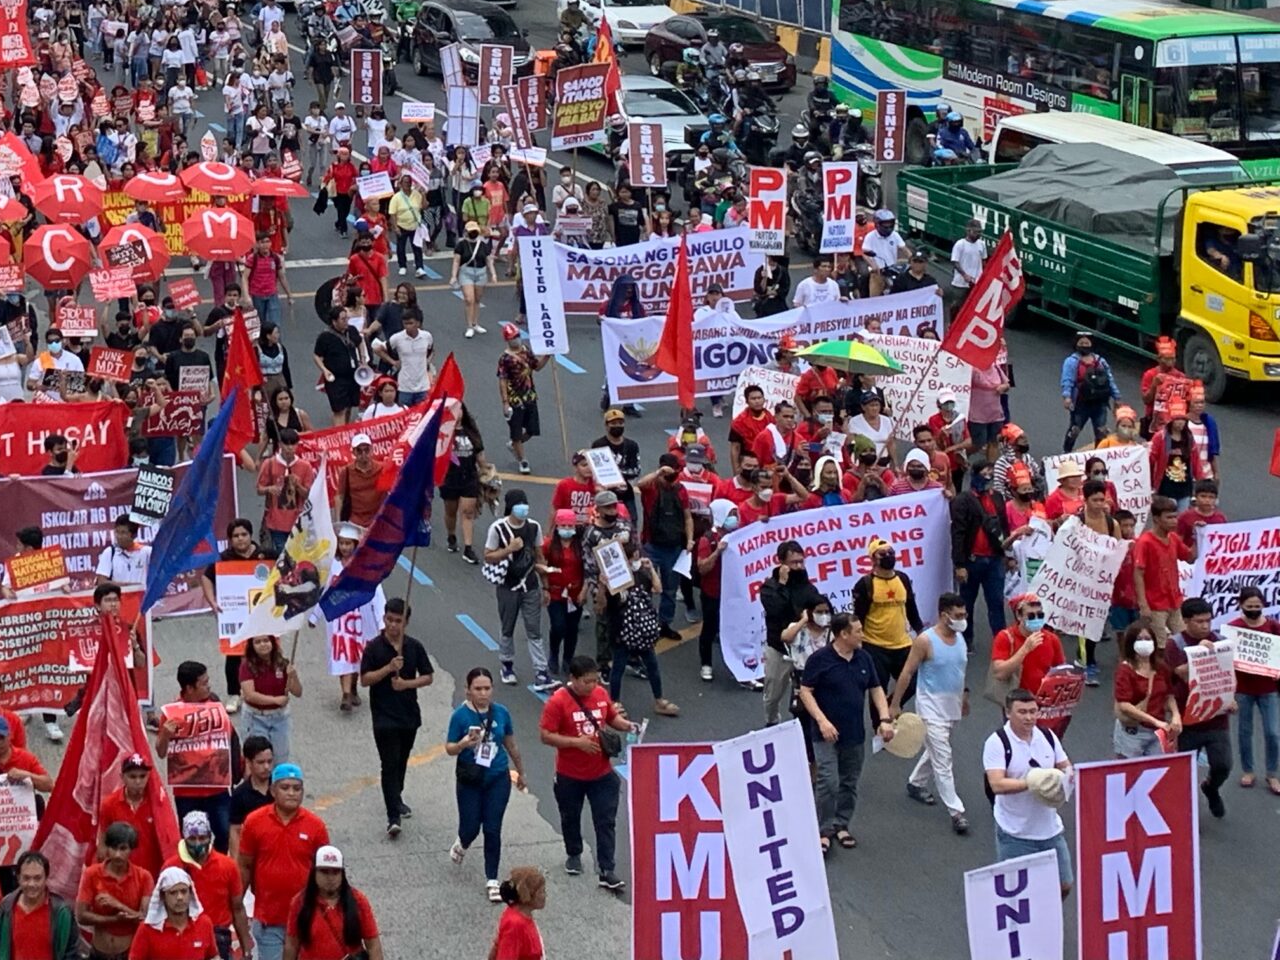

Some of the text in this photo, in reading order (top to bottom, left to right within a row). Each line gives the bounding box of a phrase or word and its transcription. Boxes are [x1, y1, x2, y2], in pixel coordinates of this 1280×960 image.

[361, 52, 373, 104] SENTRO
[487, 48, 503, 105] SENTRO
[563, 75, 604, 92] SAHOD
[958, 65, 1067, 108] Modern Room Designs
[527, 78, 539, 130] SENTRO
[557, 100, 606, 117] PRESYO
[508, 88, 526, 148] SENTRO
[882, 91, 896, 161] SENTRO
[563, 133, 595, 146] SENTRO
[640, 125, 656, 184] SENTRO
[566, 251, 588, 265] SA
[593, 254, 640, 266] SONA
[645, 248, 668, 262] NG
[531, 240, 548, 294] UNITED
[1040, 258, 1067, 275] IDEAS
[59, 307, 80, 319] STOP
[814, 318, 851, 334] PRESYO!
[896, 310, 908, 321] NA
[910, 304, 937, 320] ENDO!
[540, 303, 555, 348] LABOR
[98, 350, 124, 363] JUNK
[945, 356, 964, 369] SA
[95, 361, 128, 378] MDT!
[173, 394, 200, 405] CHINA
[1106, 447, 1131, 461] ANG
[1120, 460, 1143, 474] NG
[138, 471, 173, 489] MARCOS
[1123, 478, 1143, 492] SA
[41, 506, 107, 529] ISKOLAR NG
[738, 504, 928, 556] KATARUNGAN SA MGA
[890, 527, 926, 542] NG
[10, 550, 49, 568] STRUGGLE
[13, 557, 63, 578] NATIONALIST
[16, 567, 65, 589] EDUCATION!
[38, 673, 88, 687] IBASURA!
[741, 742, 806, 940] UNITED
[654, 753, 726, 960] KMU
